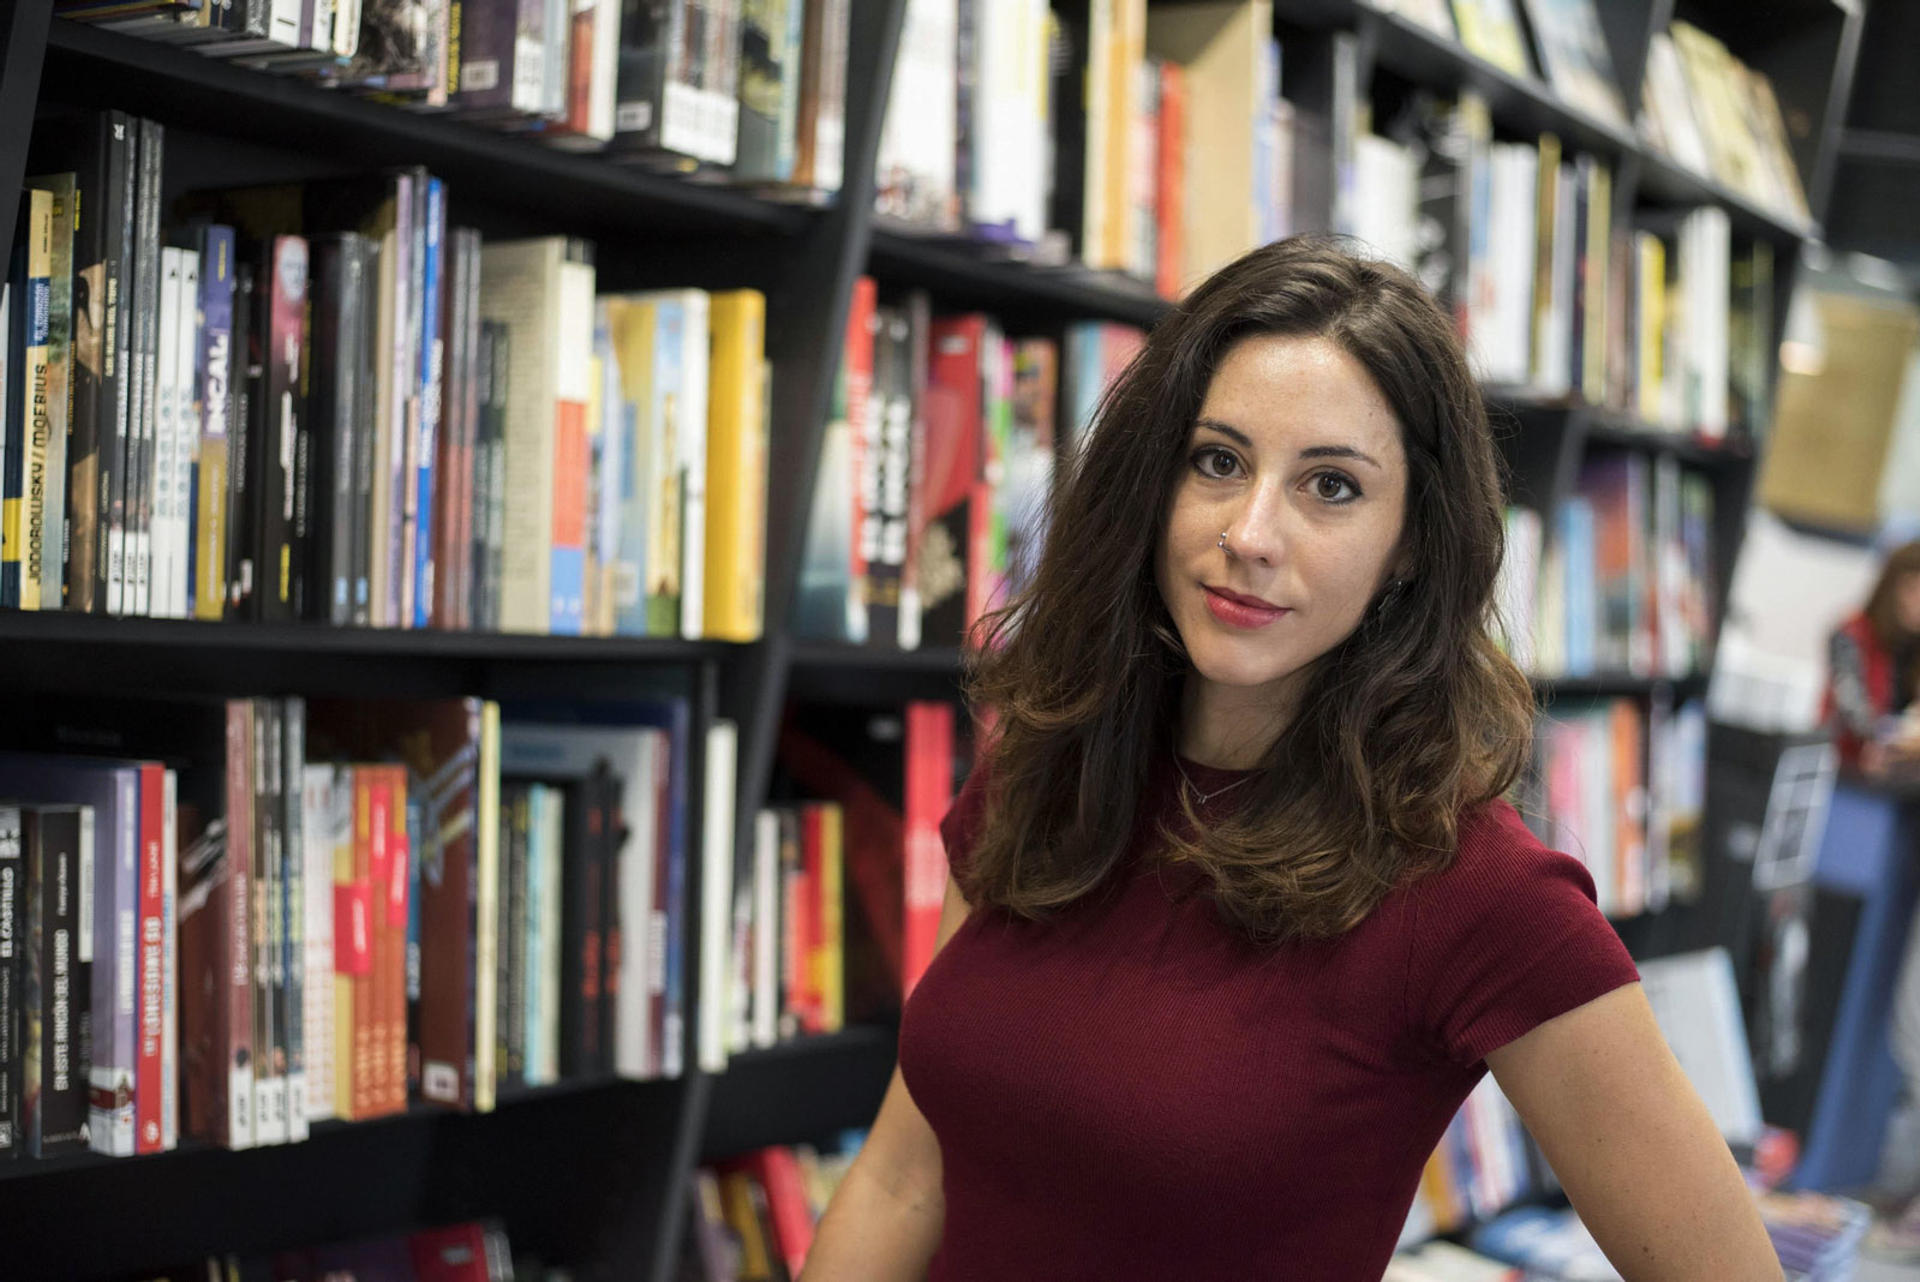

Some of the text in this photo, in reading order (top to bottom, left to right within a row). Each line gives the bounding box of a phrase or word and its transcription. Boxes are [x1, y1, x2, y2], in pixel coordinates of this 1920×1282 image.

[33, 364, 51, 448] MOEBIUS
[208, 334, 229, 435] INCAL
[29, 462, 43, 585] JODOROWSKY
[54, 928, 69, 975] MUNDO
[54, 976, 69, 999] DEL
[54, 1044, 69, 1072] ESTE
